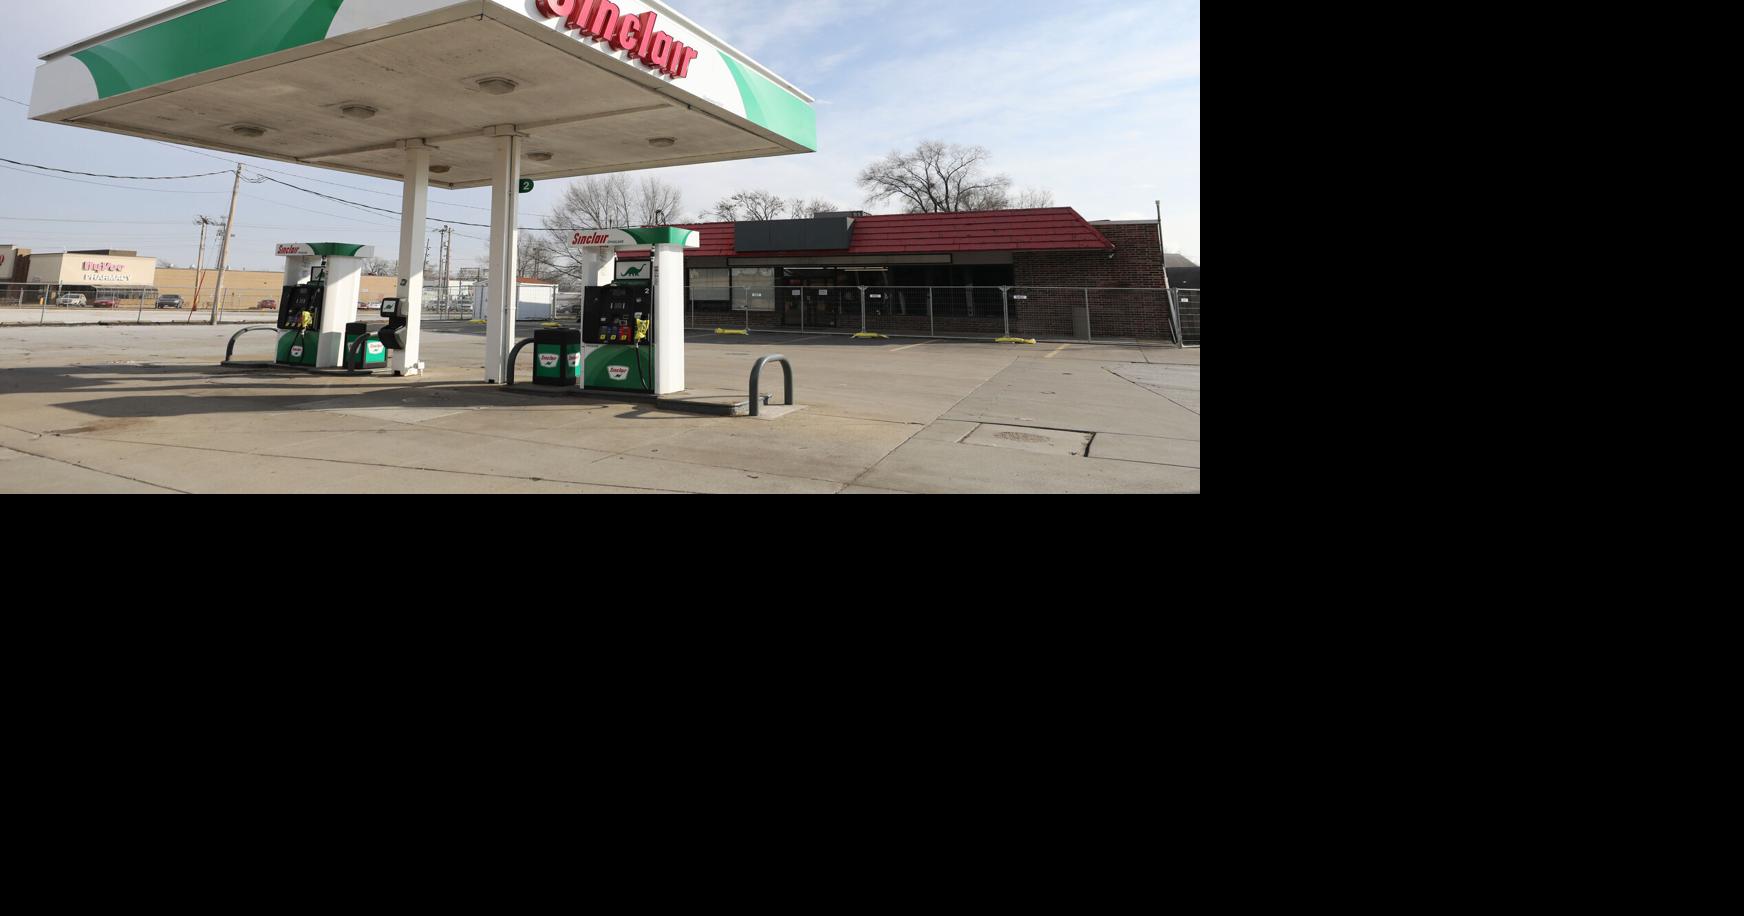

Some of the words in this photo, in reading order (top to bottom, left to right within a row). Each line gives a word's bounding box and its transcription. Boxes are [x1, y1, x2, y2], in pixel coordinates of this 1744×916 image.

[523, 181, 530, 190] 2
[572, 232, 609, 245] Sinclair
[277, 244, 300, 254] Sinclair
